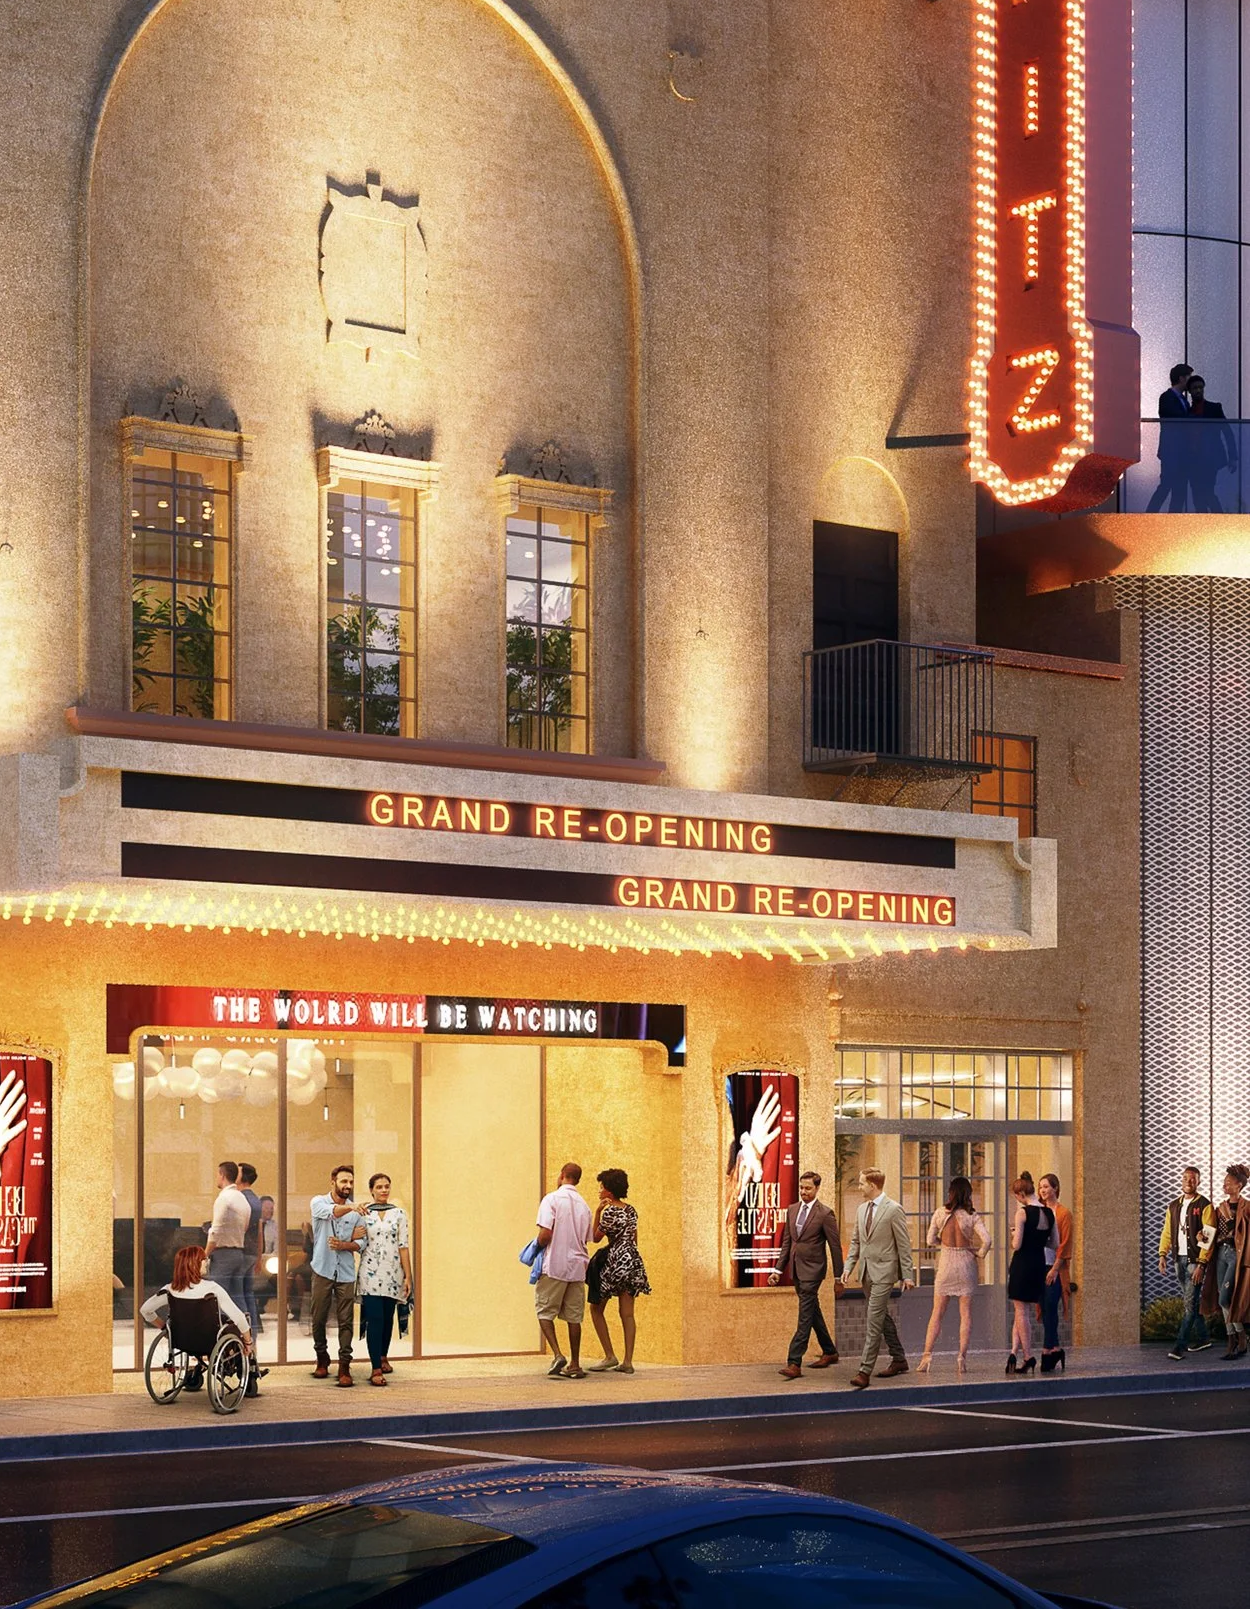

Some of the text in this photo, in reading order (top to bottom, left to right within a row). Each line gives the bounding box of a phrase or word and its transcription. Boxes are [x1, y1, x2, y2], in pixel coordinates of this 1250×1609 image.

[370, 794, 772, 853] GRAND RE-OPENING
[618, 877, 953, 925] GRAND RE-OPENING
[213, 996, 598, 1033] THE WOLRD WILL BE WATCHING
